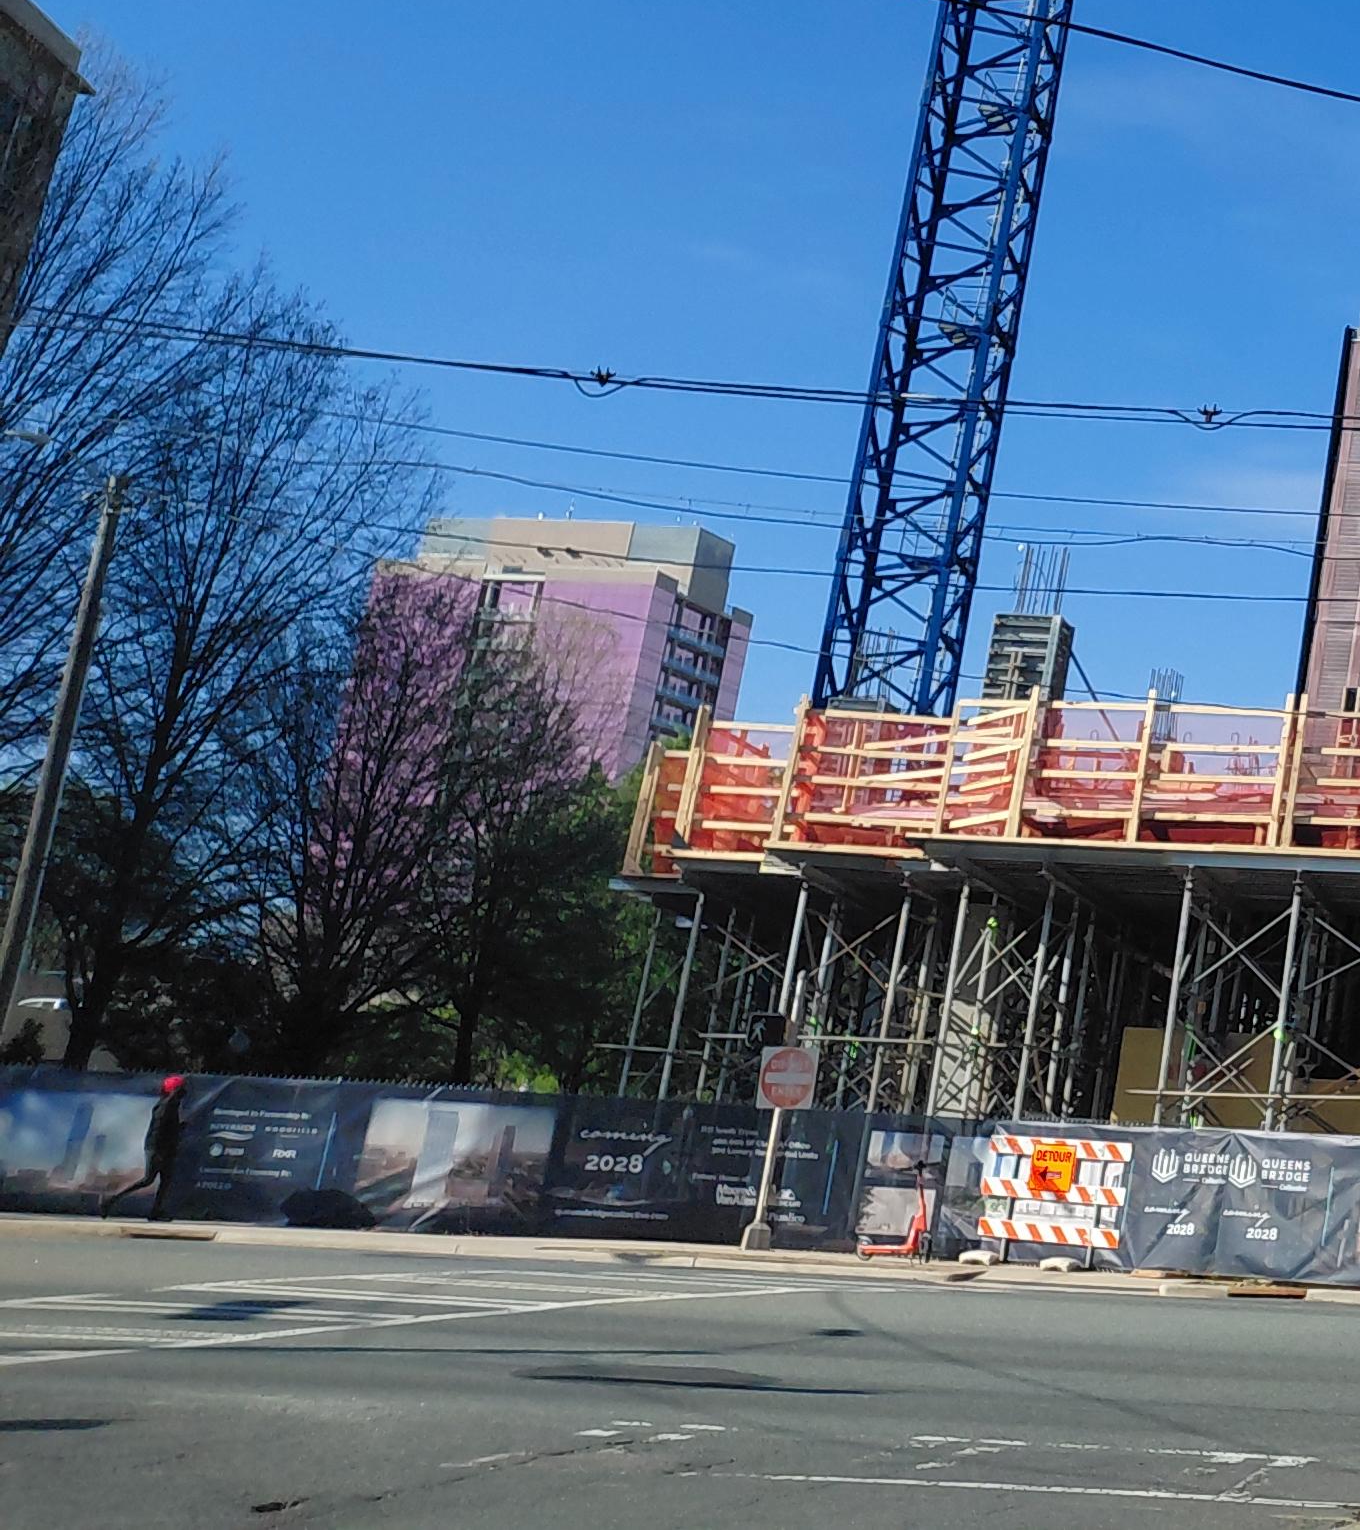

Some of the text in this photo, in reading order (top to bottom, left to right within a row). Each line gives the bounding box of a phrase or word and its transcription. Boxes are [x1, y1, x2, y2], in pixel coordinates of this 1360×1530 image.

[580, 1122, 672, 1157] coming
[1036, 1150, 1072, 1162] DETOUR
[584, 1155, 643, 1173] 2028
[1261, 1158, 1311, 1170] QUEENS
[1261, 1171, 1310, 1182] BRIDGE
[1223, 1204, 1271, 1227] coming
[1166, 1223, 1195, 1235] 2028
[1246, 1227, 1278, 1240] 2028
